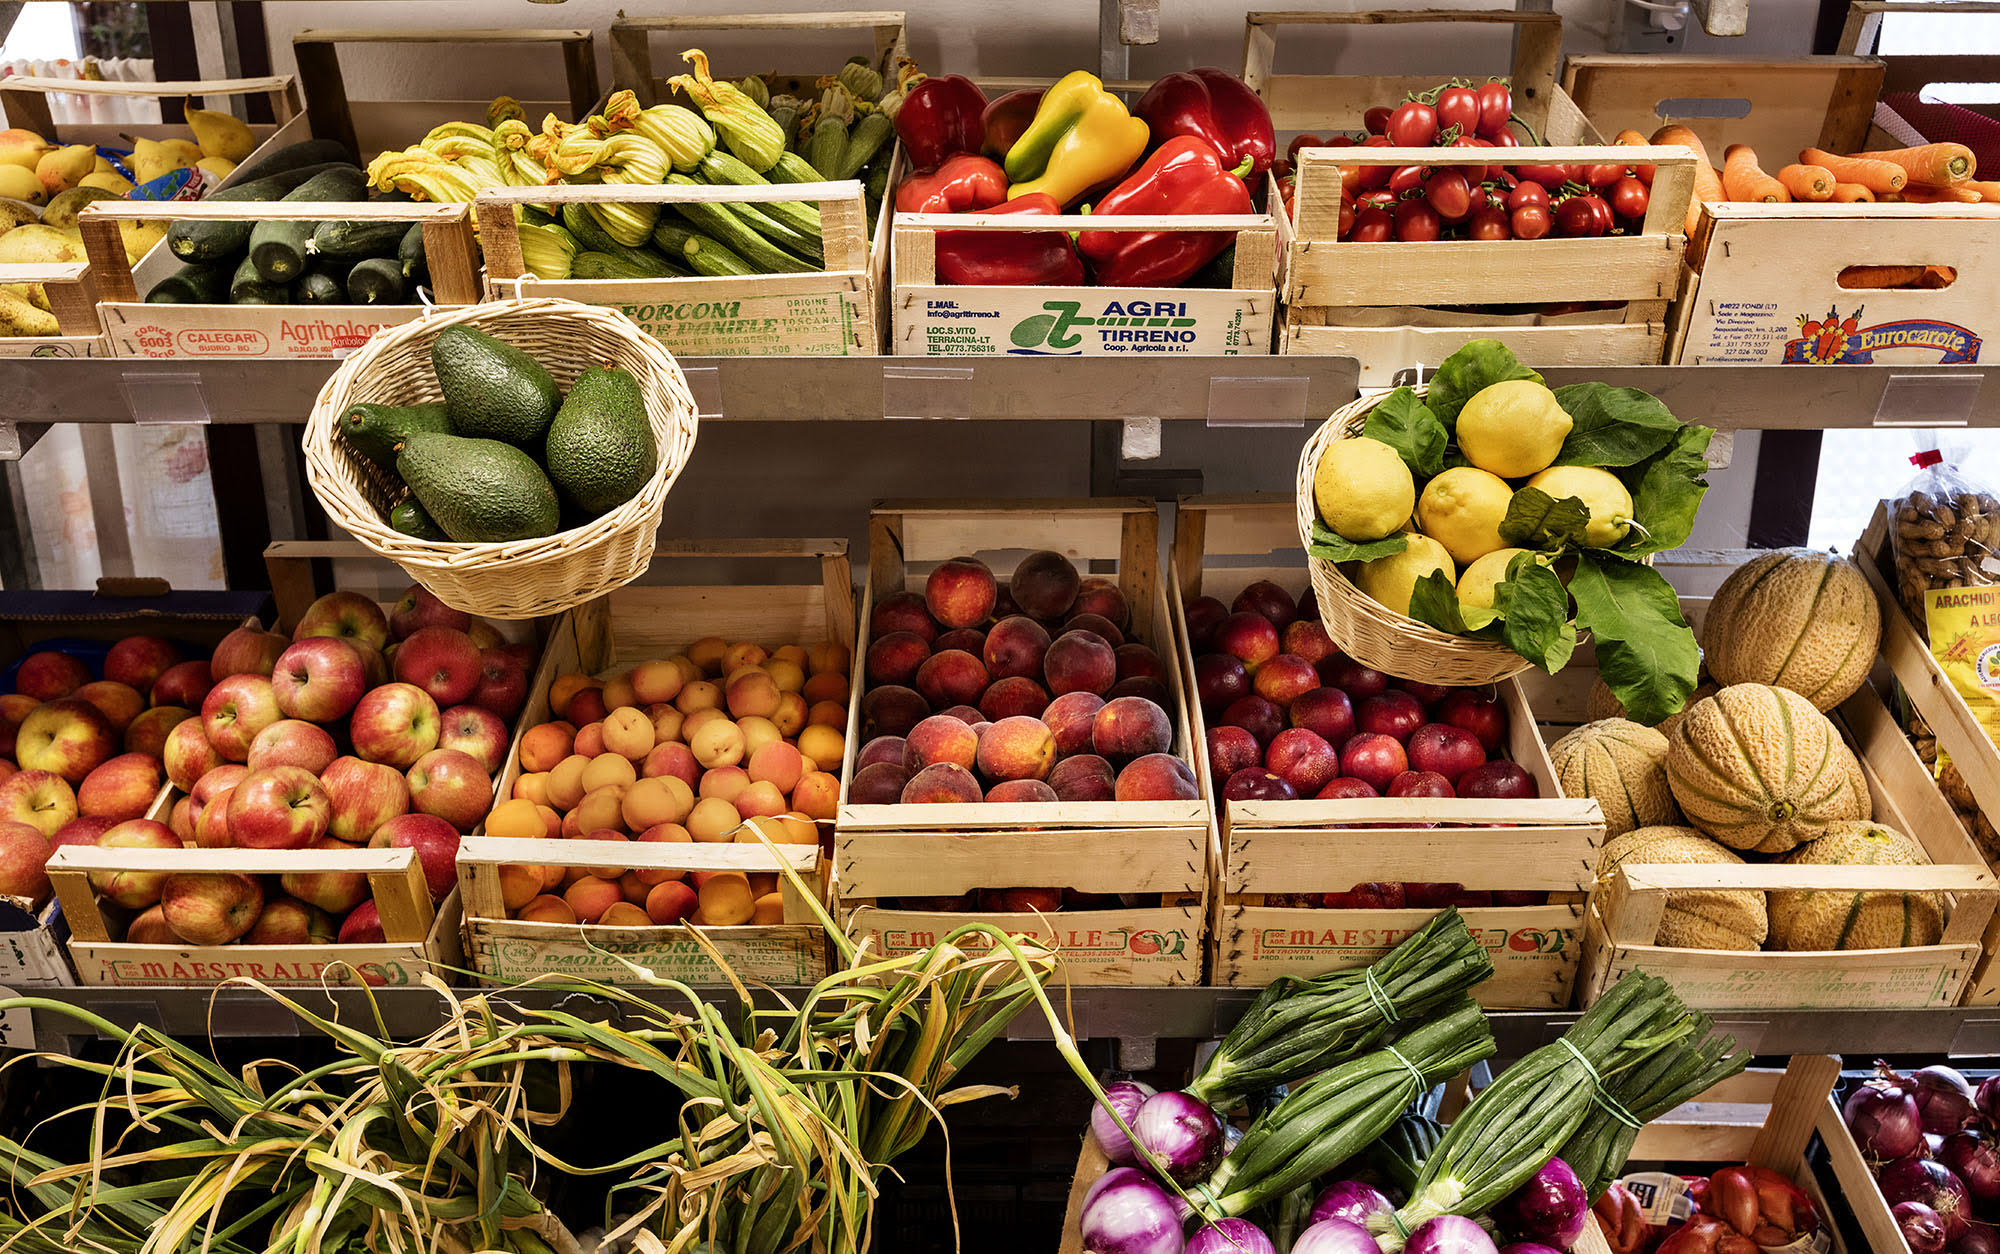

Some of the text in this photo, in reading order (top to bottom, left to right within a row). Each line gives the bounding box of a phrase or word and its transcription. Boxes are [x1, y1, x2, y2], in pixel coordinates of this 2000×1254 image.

[787, 299, 828, 308] ORIGINE
[927, 301, 959, 309] E.MAIL:
[1102, 301, 1187, 317] AGRI
[621, 302, 741, 321] FORCONI
[789, 308, 827, 316] ITALIA
[782, 317, 838, 326] TOSCANA
[134, 325, 173, 339] CODICE
[926, 327, 976, 335] LOC.S.VITO
[1098, 330, 1197, 343] TIRRENO
[139, 337, 173, 348] 6003
[187, 333, 257, 343] CALEGARI
[926, 336, 991, 344] TERRACINA-LT
[1859, 330, 1966, 352] Eurocarote
[1103, 344, 1129, 352] Coop.
[1131, 344, 1166, 352] Agricola
[1936, 592, 1995, 609] ARACHIDI
[1971, 615, 1979, 627] A
[543, 954, 616, 966] PAOLO
[641, 955, 736, 965] DANIEE
